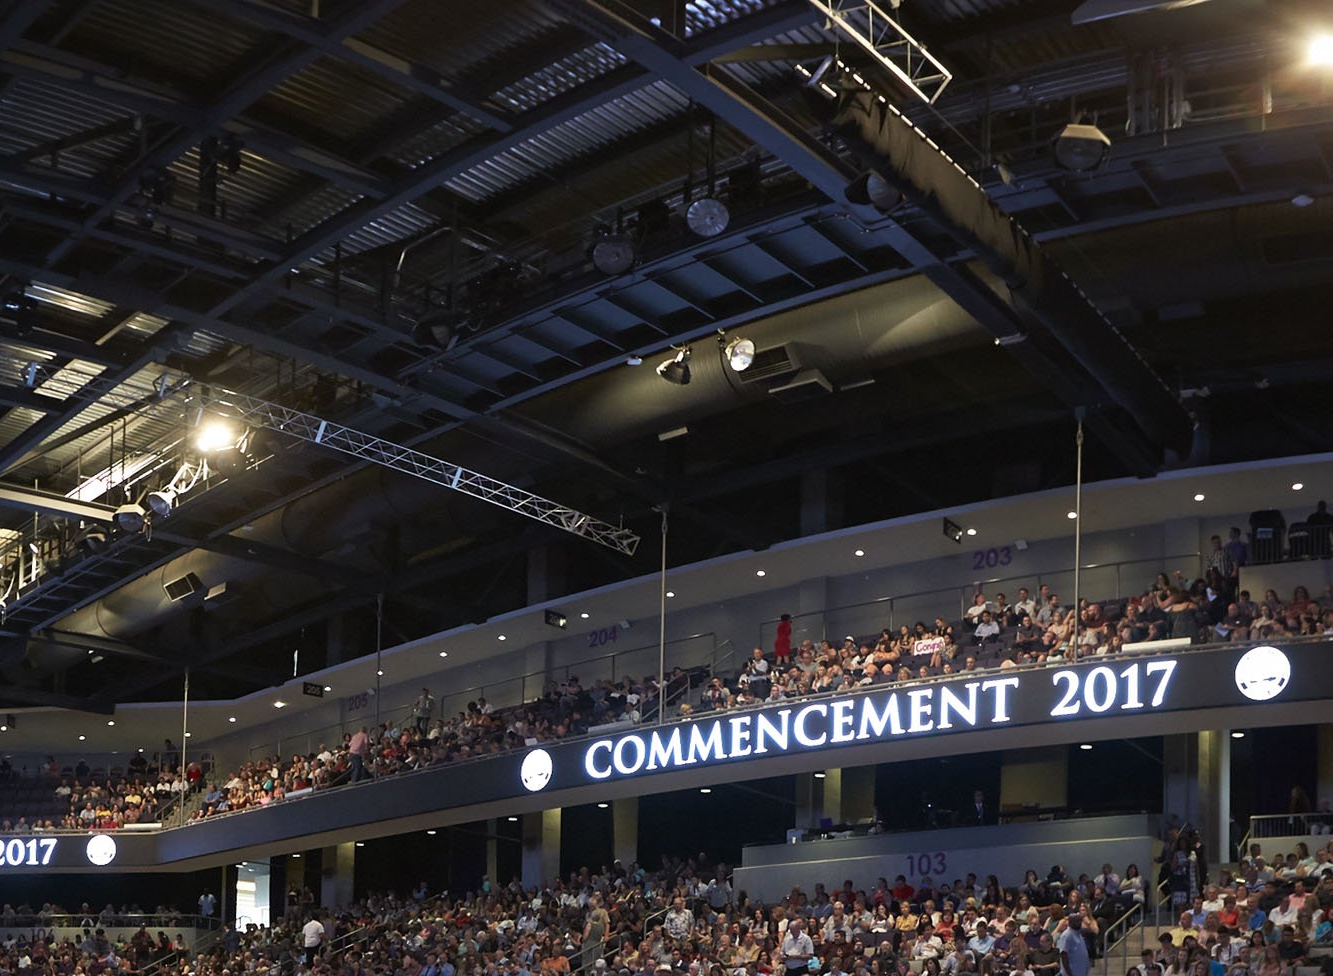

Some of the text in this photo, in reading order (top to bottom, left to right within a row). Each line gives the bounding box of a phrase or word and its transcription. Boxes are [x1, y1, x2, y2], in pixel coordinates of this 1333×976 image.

[972, 546, 1013, 571] 203
[588, 625, 618, 649] 204
[348, 693, 369, 712] 205
[584, 659, 1178, 779] COMMENCEMENT 2017
[907, 852, 947, 878] 103
